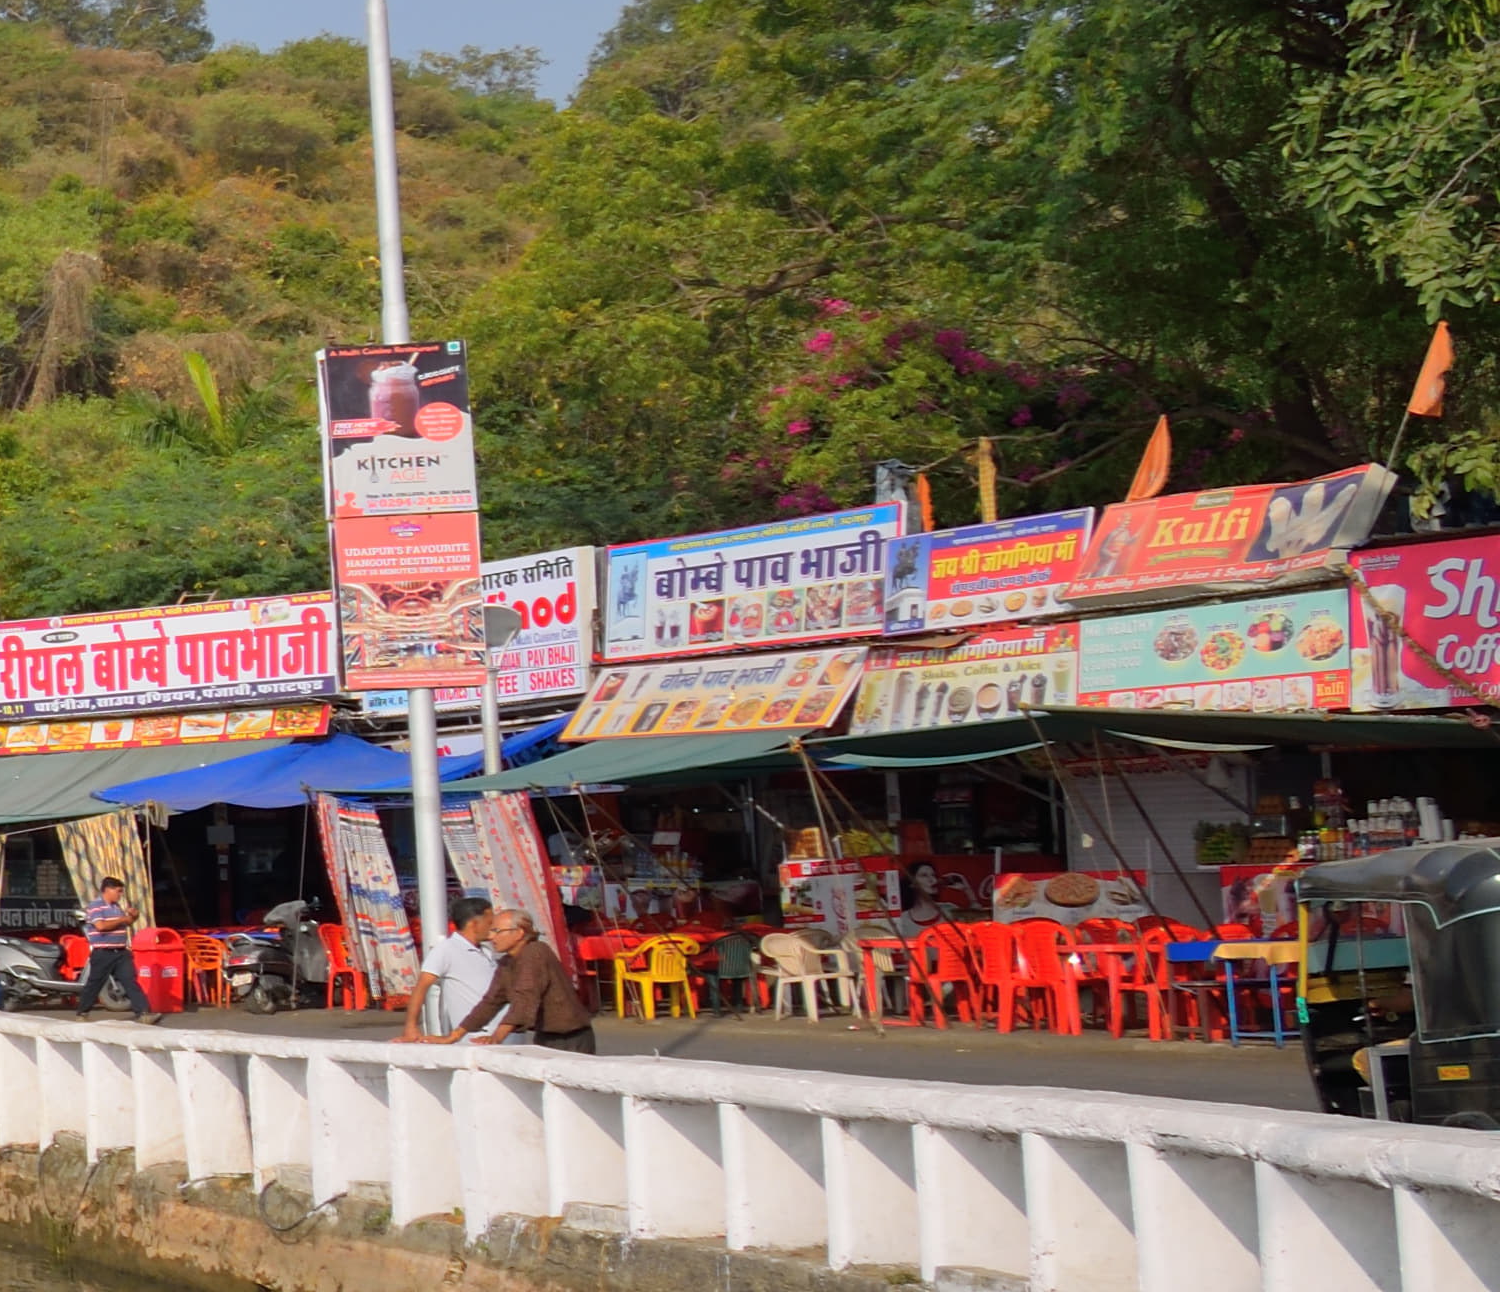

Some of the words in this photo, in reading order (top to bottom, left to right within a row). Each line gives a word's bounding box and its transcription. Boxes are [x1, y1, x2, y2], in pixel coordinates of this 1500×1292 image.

[357, 455, 441, 477] KITCHEN
[390, 469, 427, 481] AGE
[1148, 508, 1252, 548] Kulfi
[344, 545, 403, 557] UDAIPUR'S
[406, 543, 471, 554] FAVOURITE
[346, 558, 397, 568] HANGOUT
[400, 555, 471, 566] DESTINATION
[522, 556, 575, 584] समिति
[655, 551, 727, 601] बोम्बे
[732, 551, 795, 590] पाव
[800, 529, 887, 581] भाजी
[932, 557, 959, 580] जय
[961, 548, 981, 575] श्री
[1071, 582, 1089, 593] Mr.
[1096, 577, 1135, 593] Healthy
[1138, 572, 1172, 586] Herbal
[1176, 568, 1209, 582] Juice
[1226, 565, 1260, 580] Super
[1265, 560, 1288, 573] Food
[1423, 557, 1500, 629] Sh
[91, 620, 170, 691] बोम्बे
[175, 607, 332, 686] पावभाजी
[527, 648, 545, 668] PAV
[548, 644, 575, 666] BHAJI
[529, 668, 576, 691] SHAKES
[963, 664, 999, 677] Coffee
[1002, 663, 1012, 672] &
[1015, 660, 1042, 672] Juice
[1316, 682, 1345, 696] Kulfi
